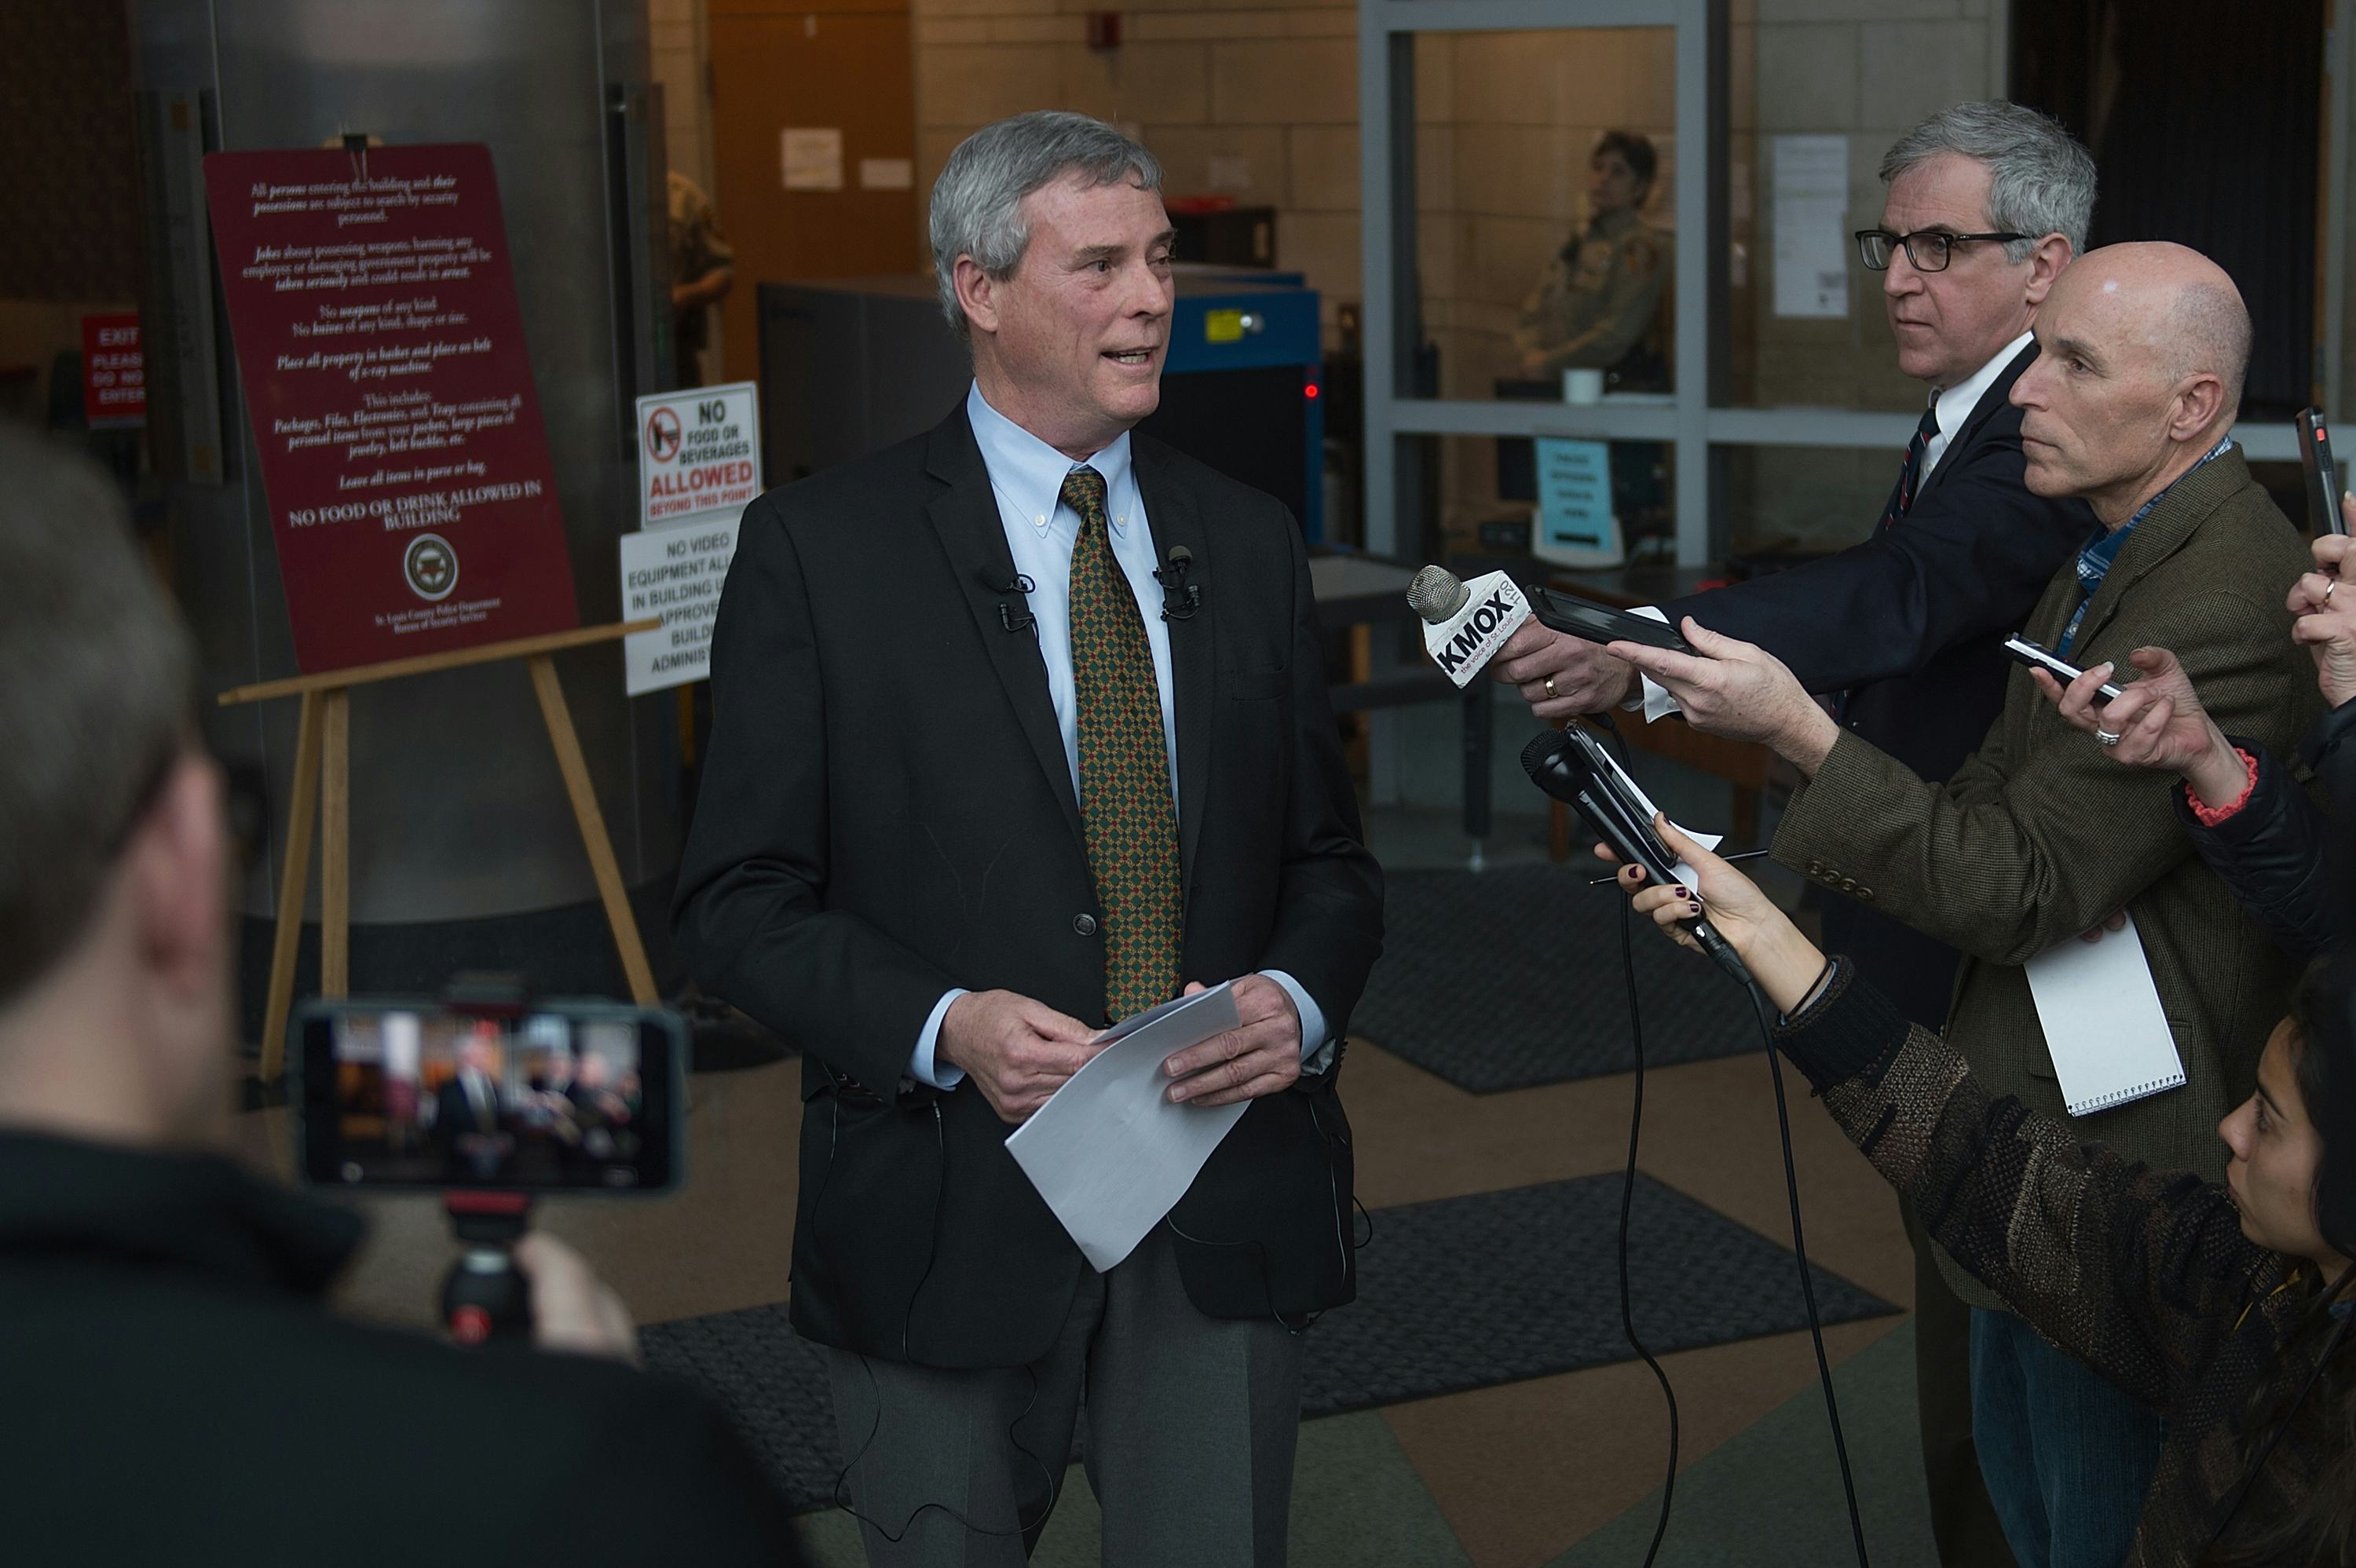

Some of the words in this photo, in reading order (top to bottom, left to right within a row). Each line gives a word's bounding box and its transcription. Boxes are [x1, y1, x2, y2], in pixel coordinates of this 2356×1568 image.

[269, 184, 306, 199] persons
[309, 180, 349, 197] entering
[368, 177, 410, 194] building
[413, 174, 430, 188] and
[433, 174, 456, 188] their
[251, 198, 307, 217] possessions
[326, 195, 362, 211] subject
[364, 196, 374, 207] to
[407, 190, 419, 207] by
[254, 245, 281, 264] Jokes
[294, 264, 305, 275] or
[358, 255, 415, 272] government
[275, 276, 304, 292] taken
[306, 272, 349, 291] seriously
[350, 271, 369, 287] and
[320, 303, 338, 320] No
[339, 304, 381, 320] weapons
[383, 298, 394, 314] of
[396, 300, 412, 316] any
[100, 327, 139, 347] EXIT
[292, 320, 310, 338] No
[312, 319, 344, 334] knives
[346, 316, 357, 332] of
[358, 320, 376, 334] any
[92, 353, 144, 368] PLEAS
[276, 354, 305, 371] Place
[306, 353, 321, 367] all
[323, 352, 364, 370] property
[366, 349, 377, 361] in
[379, 345, 410, 361] basket
[412, 342, 430, 358] and
[433, 338, 457, 357] place
[459, 342, 471, 354] on
[473, 336, 492, 353] belt
[92, 371, 115, 387] DO
[121, 370, 145, 386] NO
[349, 365, 360, 382] of
[364, 393, 386, 410] This
[410, 404, 429, 419] and
[699, 399, 726, 425] NO
[288, 432, 331, 452] personal
[333, 430, 359, 444] items
[360, 426, 386, 441] from
[388, 423, 411, 439] your
[451, 416, 476, 433] large
[477, 413, 504, 431] pieces
[505, 411, 517, 425] of
[686, 427, 720, 447] FOOD
[722, 424, 739, 440] OR
[390, 437, 409, 454] belt
[679, 440, 749, 466] BEVERAGES
[339, 473, 368, 491] Leave
[370, 470, 384, 487] all
[386, 468, 412, 485] items
[414, 466, 425, 480] in
[426, 465, 452, 483] purse
[454, 464, 465, 477] or
[649, 459, 753, 499] ALLOWED
[289, 510, 316, 528] NO
[318, 502, 367, 524] FOOD
[369, 498, 394, 517] OR
[396, 490, 449, 514] DRINK
[449, 484, 521, 506] ALLOWED
[523, 479, 544, 497] IN
[649, 496, 691, 517] BEYOND
[694, 491, 718, 510] THIS
[720, 485, 753, 506] POINT
[383, 506, 462, 532] BUILDING
[667, 539, 686, 558] NO
[690, 532, 730, 553] VIDEO
[628, 558, 705, 590] EQUIPMENT
[632, 594, 645, 611] IN
[649, 579, 712, 607] BUILDING
[1500, 580, 1521, 605] 1120
[658, 598, 719, 627] APPROVE
[1437, 589, 1514, 674] KMOX
[652, 645, 710, 673] ADMINIS
[1461, 663, 1472, 674] the
[1471, 647, 1486, 663] voice
[1486, 638, 1492, 648] of
